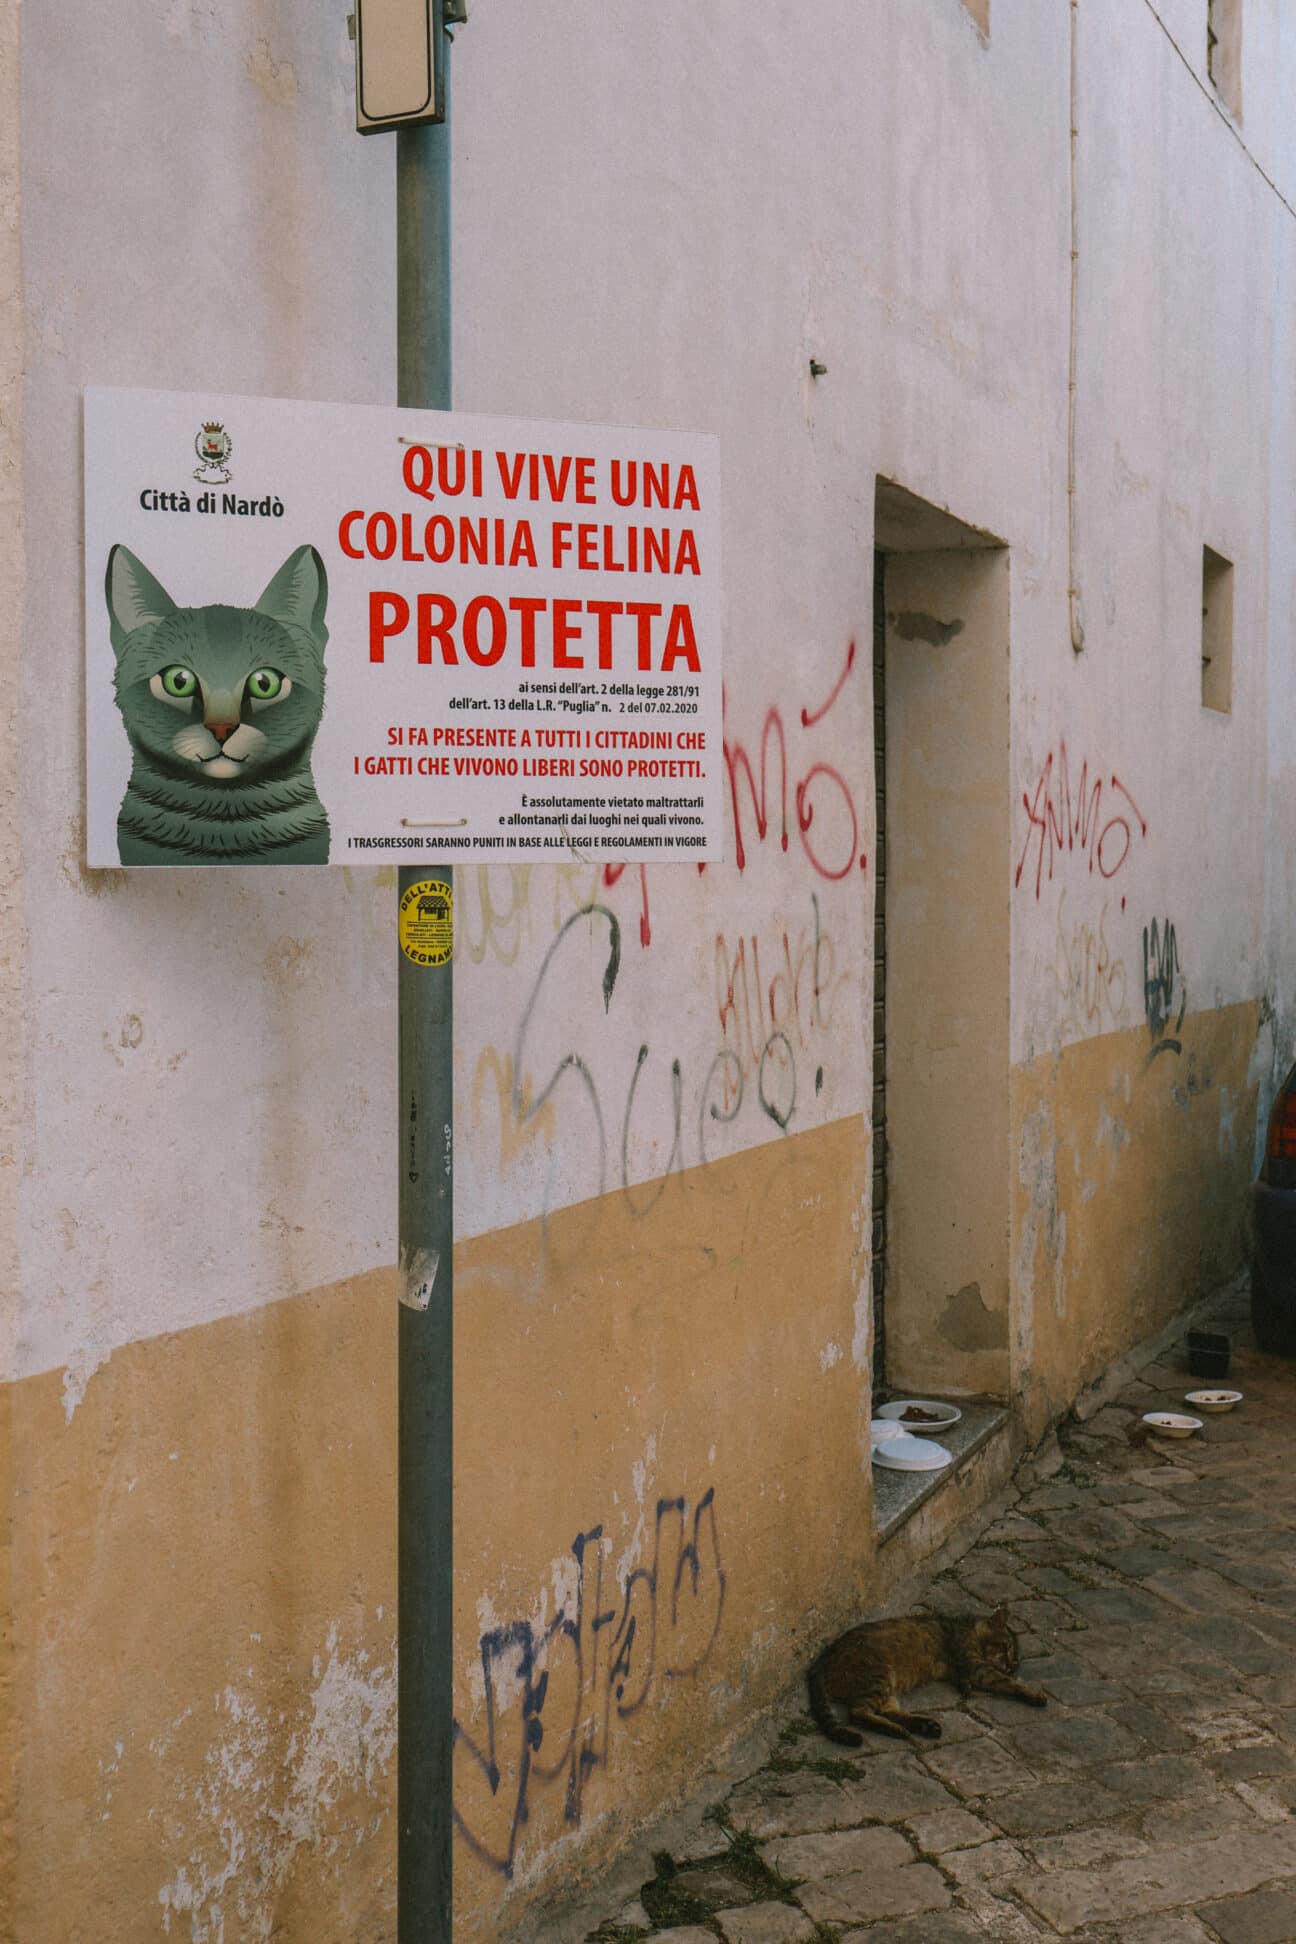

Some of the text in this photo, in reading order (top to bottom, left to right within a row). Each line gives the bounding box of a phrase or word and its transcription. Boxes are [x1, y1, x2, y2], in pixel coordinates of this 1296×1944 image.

[402, 445, 702, 512] QUI VIVE UNA
[140, 488, 285, 518] Città di Nardò
[338, 509, 702, 577] COLONIA FELINA
[368, 590, 702, 673] PROTETTA
[518, 682, 529, 693] ai
[530, 682, 557, 694] sensi
[600, 684, 608, 695] 2
[609, 683, 635, 696] della
[636, 684, 665, 700] legge
[665, 685, 700, 698] 281/91
[493, 698, 506, 711] 13
[507, 699, 535, 712] della
[536, 699, 557, 712] L.R.
[601, 704, 612, 713] n.
[619, 702, 625, 713] 2
[627, 702, 643, 713] del
[644, 702, 698, 714] 07.02.2020
[387, 726, 706, 751] SI FA PRESENTE A TUTTI I CITTADINI CHE
[354, 756, 707, 779] I GATTI CHE VIVONO LIBERI SONO PROTETTI.
[521, 793, 705, 809] È assolutamente vietato maltrattarli
[498, 812, 705, 829] e allontanarli dai luoghi nei quali vivono.
[347, 836, 708, 849] I TRASGRESSORI SARANNO PUNITI IN BASE ALLE LEGGI E REGOLAMENTI IN VIGORE
